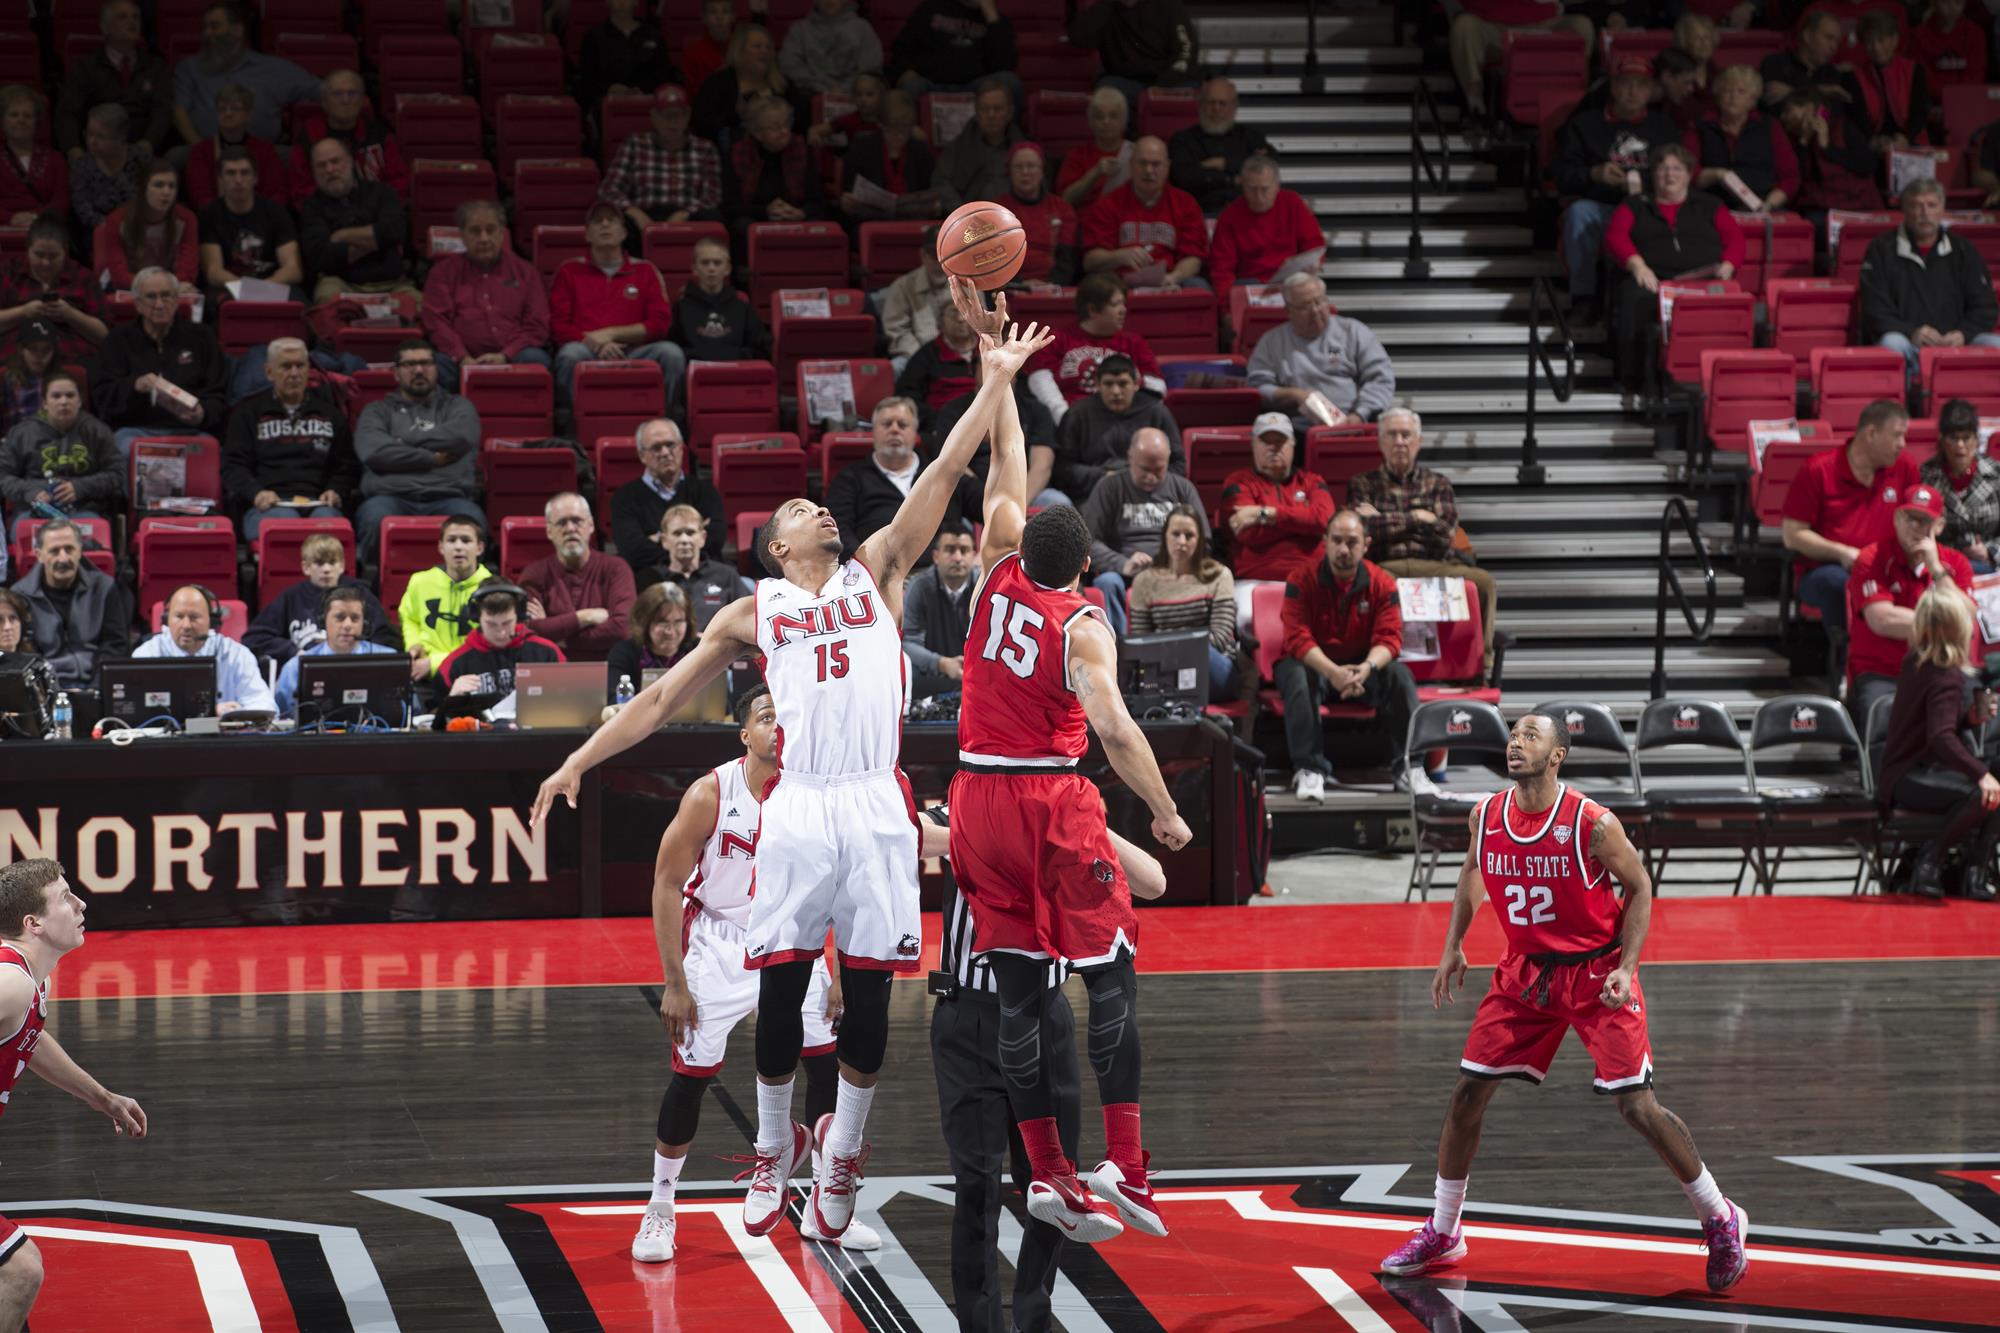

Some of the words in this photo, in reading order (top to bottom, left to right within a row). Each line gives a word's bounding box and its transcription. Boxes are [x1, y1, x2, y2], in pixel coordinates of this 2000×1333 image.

[257, 418, 334, 441] HUSKIES
[767, 591, 878, 650] NIU
[982, 592, 1045, 679] 15
[814, 639, 850, 683] 15
[0, 807, 548, 893] NORTHERN
[1487, 852, 1521, 876] BALL
[1525, 855, 1570, 877] STATE
[1504, 884, 1557, 926] 22
